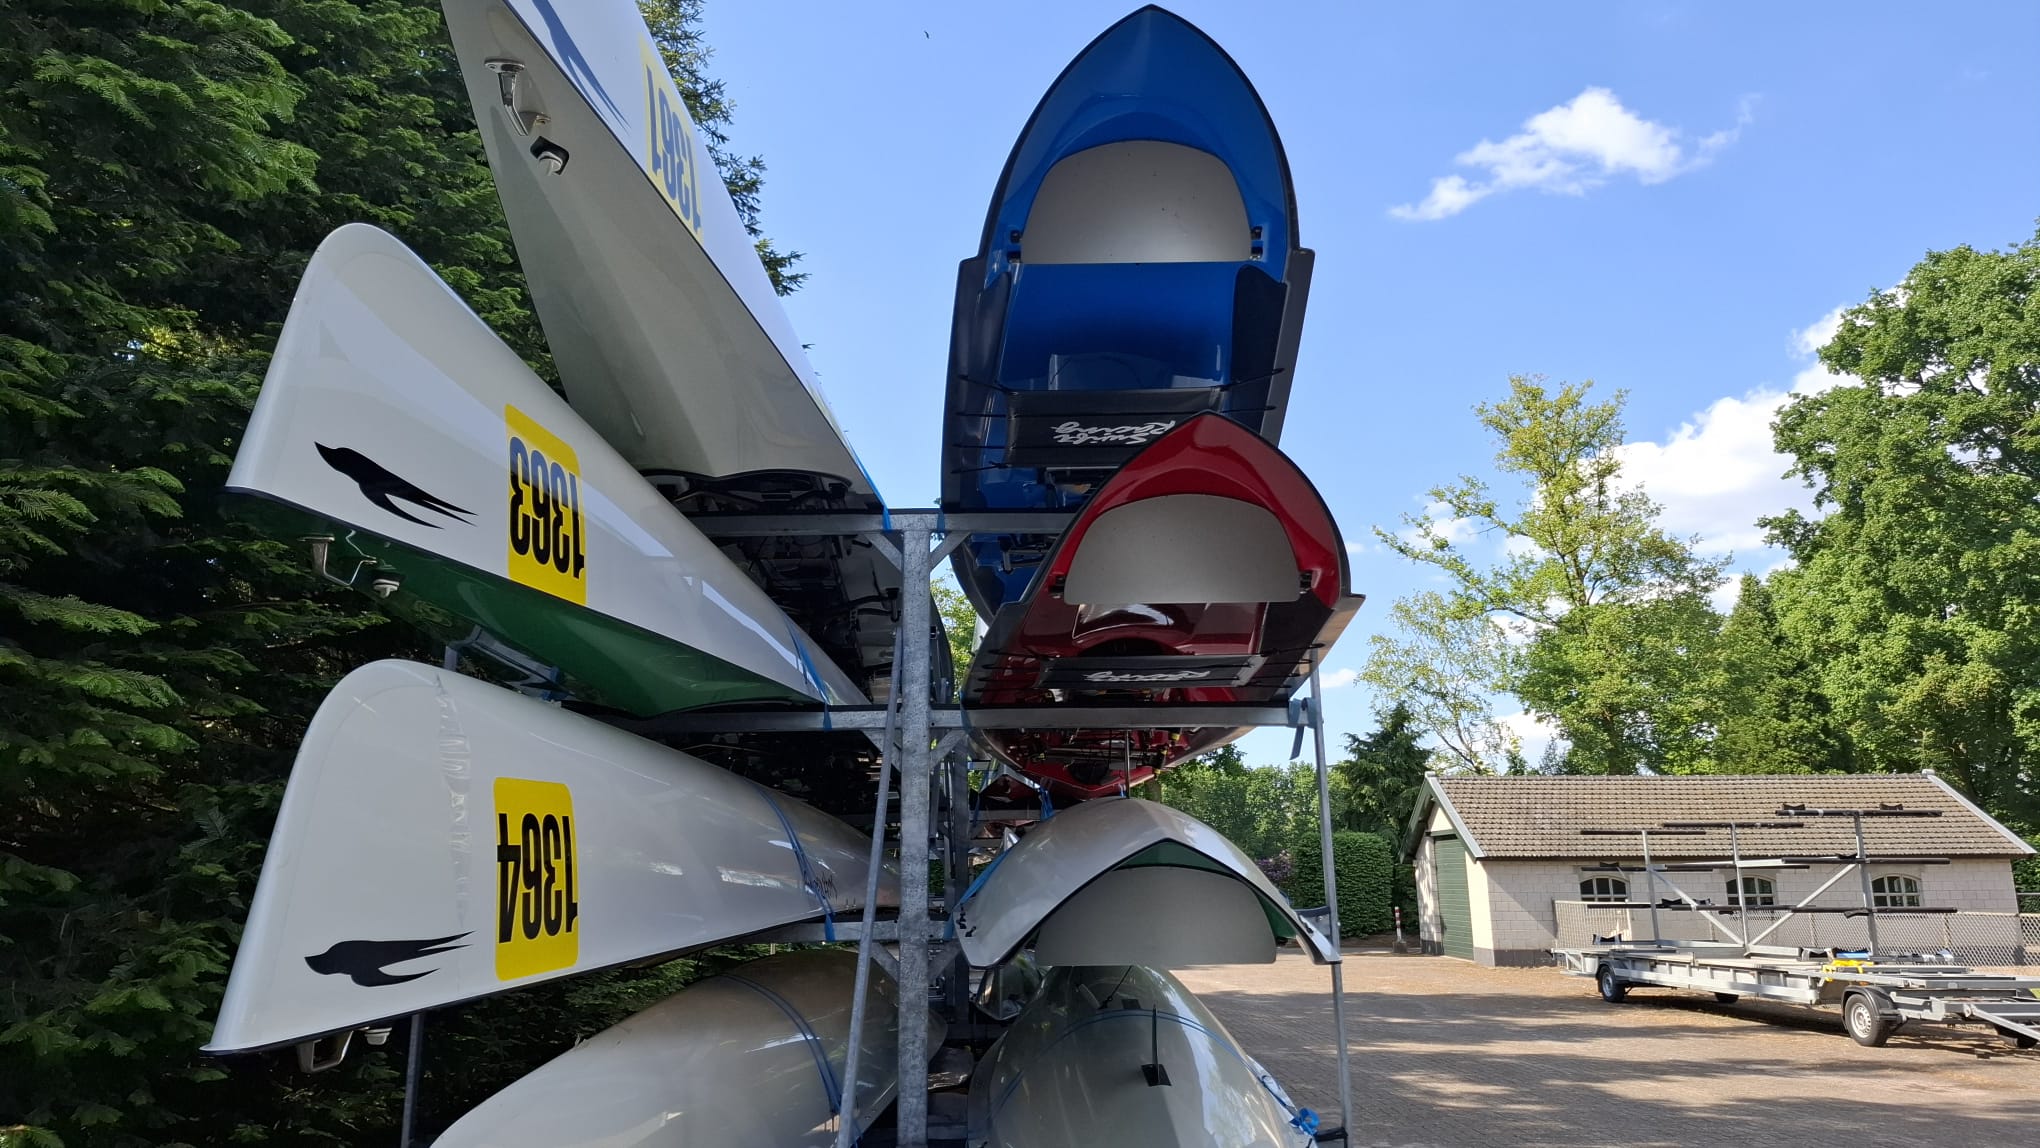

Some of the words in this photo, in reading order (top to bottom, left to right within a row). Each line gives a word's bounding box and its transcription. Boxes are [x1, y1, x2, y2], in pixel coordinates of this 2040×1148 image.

[646, 64, 702, 235] 1361
[1051, 420, 1176, 435] Racing
[1053, 432, 1150, 445] Swift
[509, 436, 585, 579] 1363
[497, 813, 578, 943] 1364
